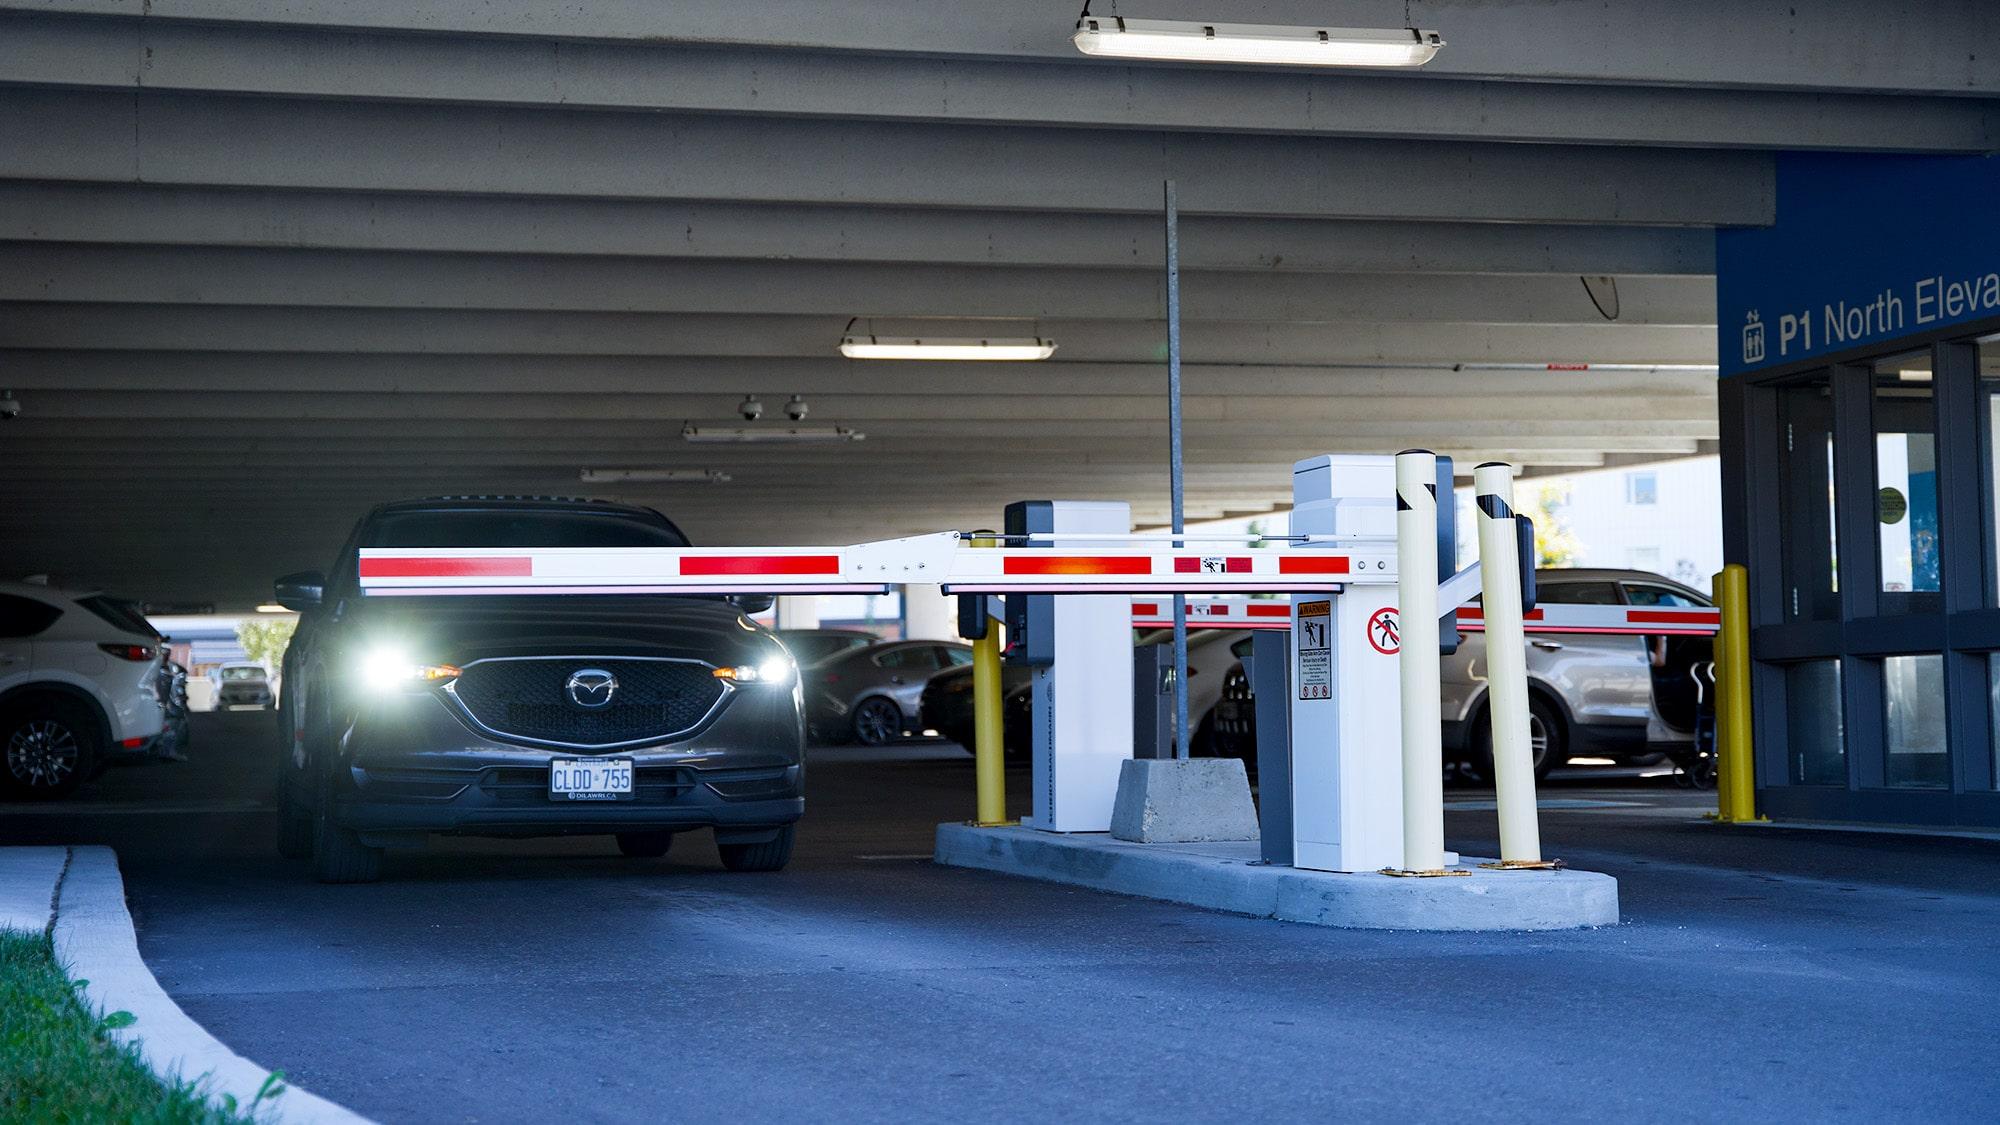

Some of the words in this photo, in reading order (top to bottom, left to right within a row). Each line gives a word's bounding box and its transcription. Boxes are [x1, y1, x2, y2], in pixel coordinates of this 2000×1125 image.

[1780, 310, 1811, 356] P1
[1825, 288, 1903, 345] North
[1916, 272, 2000, 325] Eleva
[1303, 603, 1330, 614] WARNING
[554, 769, 592, 790] CLDD
[602, 768, 630, 789] 755
